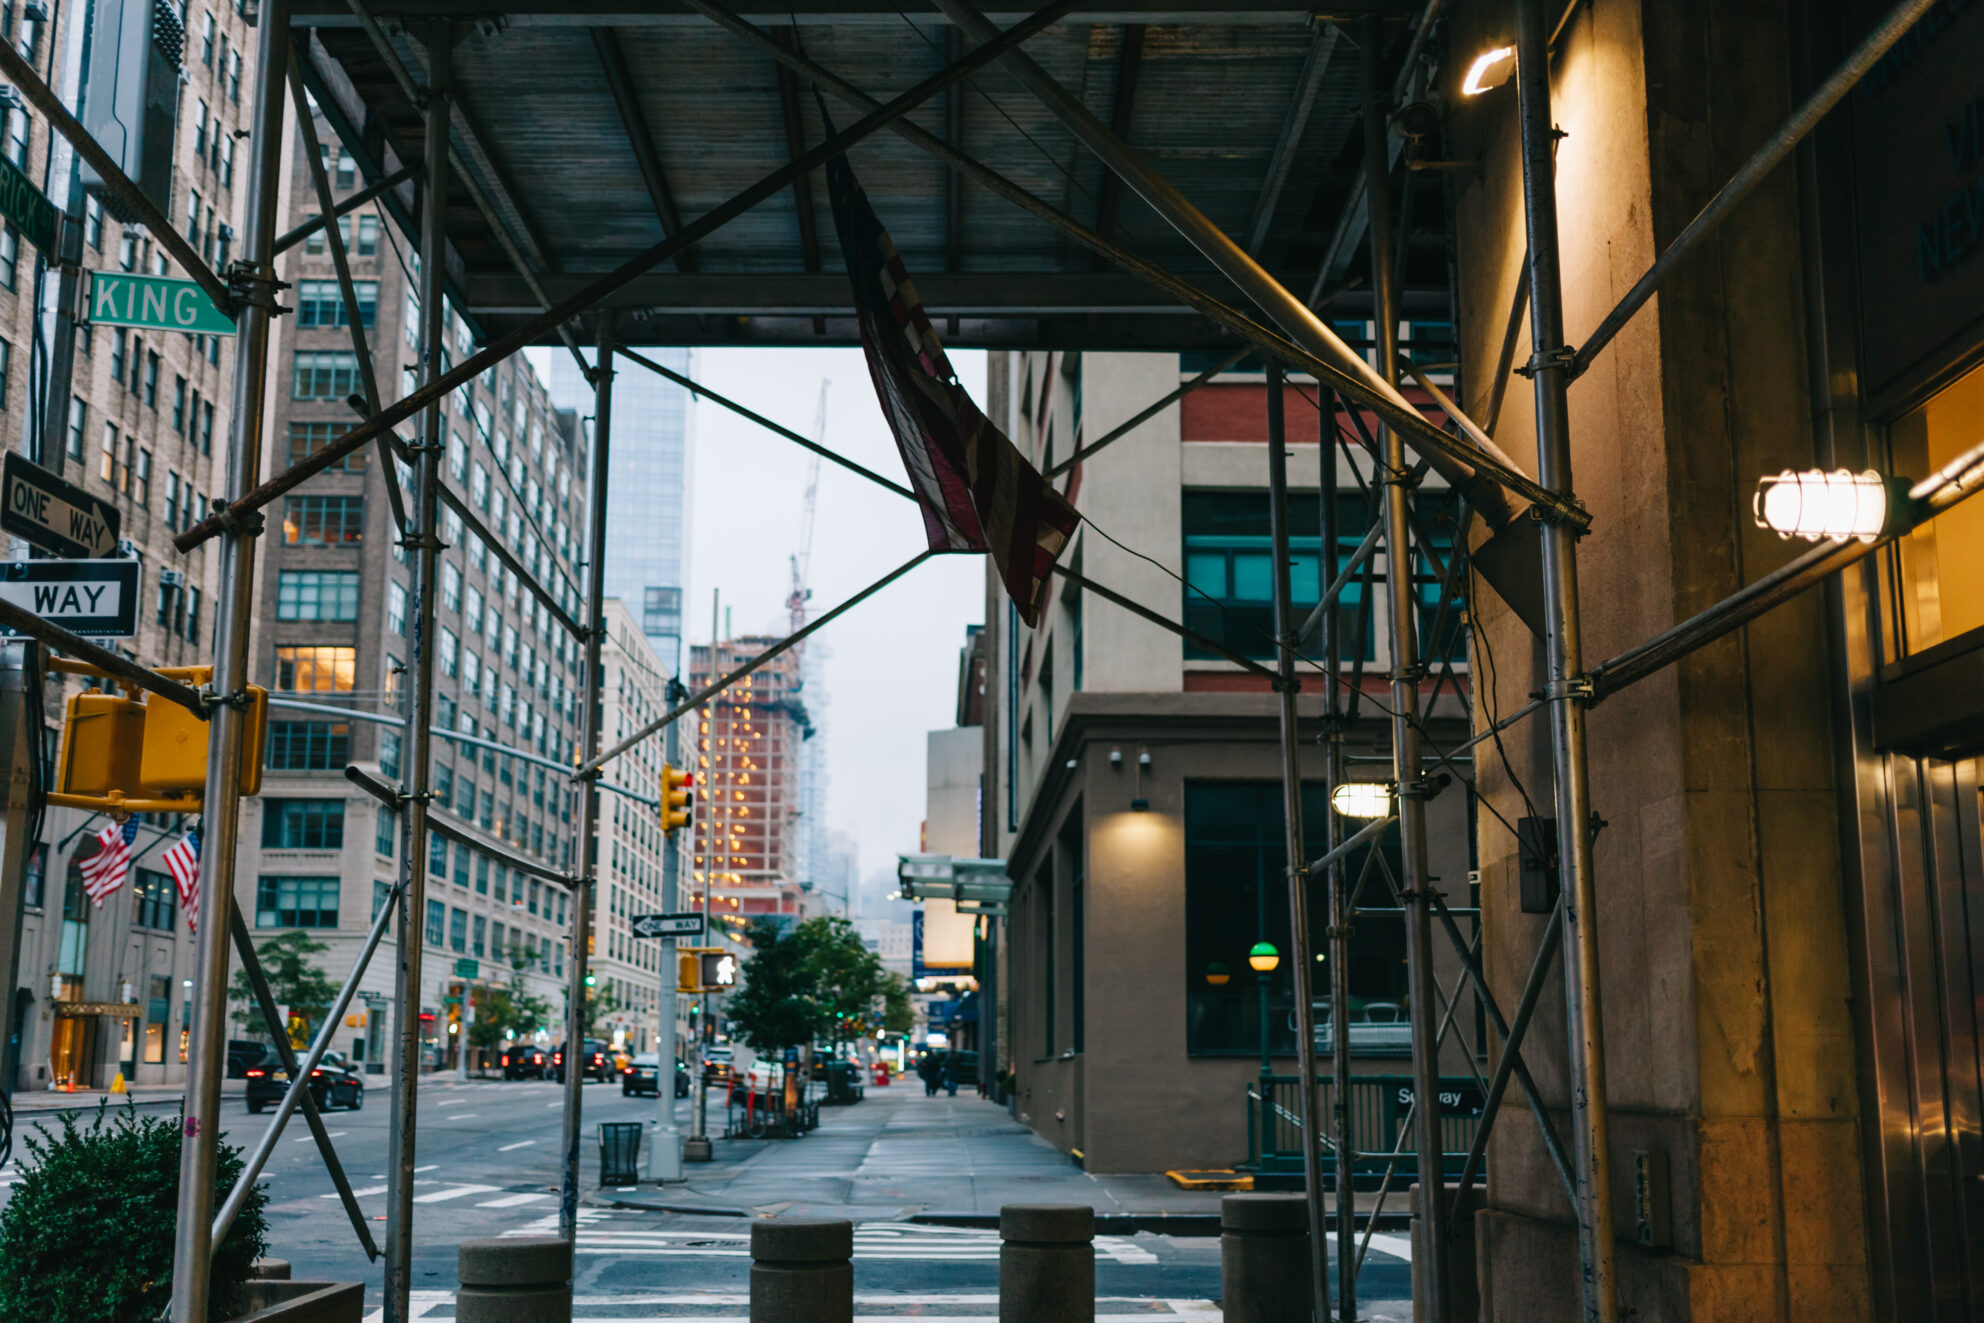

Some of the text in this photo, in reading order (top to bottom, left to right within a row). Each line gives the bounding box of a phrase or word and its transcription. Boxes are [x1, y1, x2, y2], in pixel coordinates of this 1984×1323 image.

[95, 279, 198, 326] KING
[14, 482, 51, 525] ONE
[70, 509, 105, 549] WAY
[34, 585, 106, 613] WAY
[641, 920, 698, 931] ONE WAY
